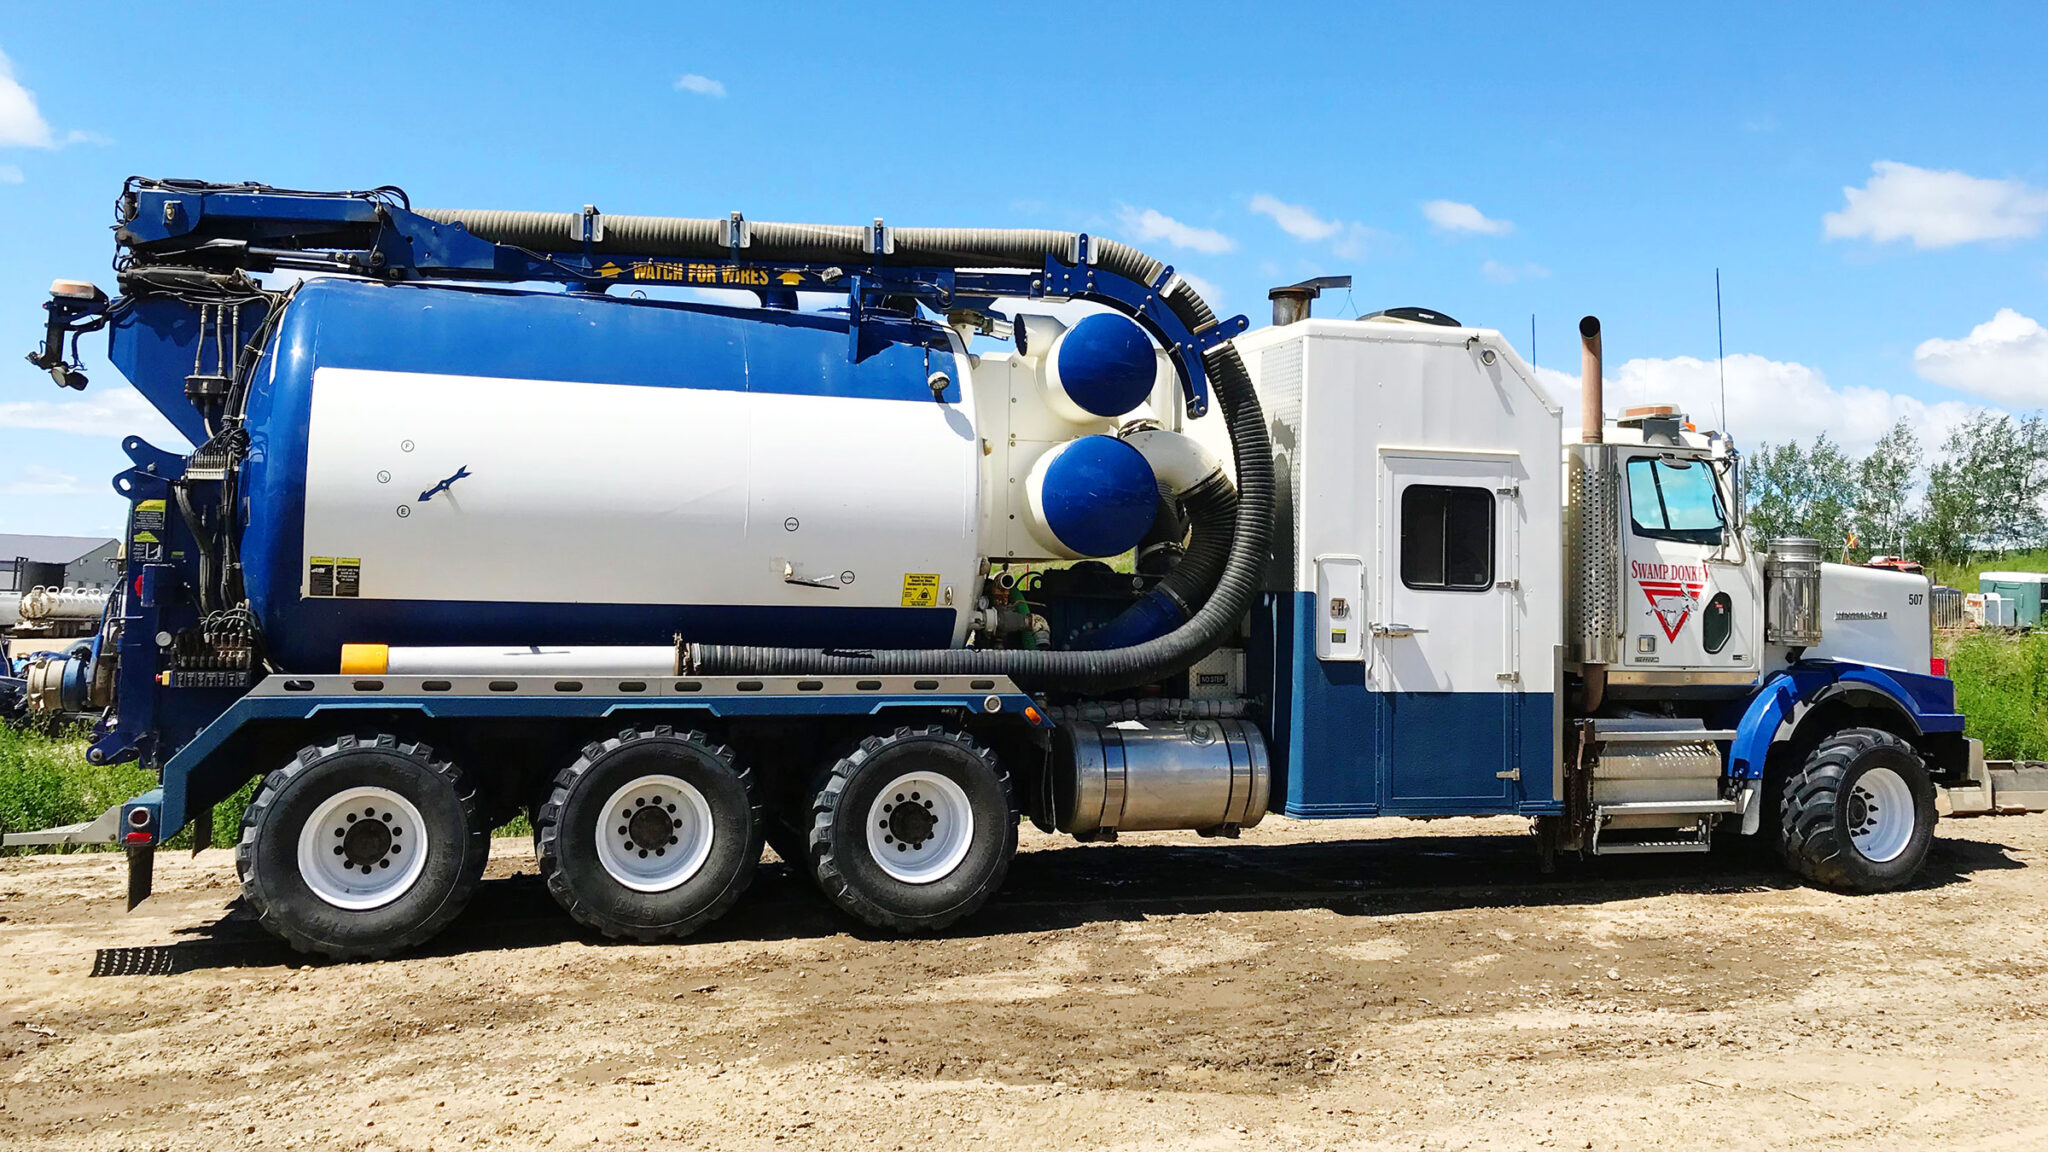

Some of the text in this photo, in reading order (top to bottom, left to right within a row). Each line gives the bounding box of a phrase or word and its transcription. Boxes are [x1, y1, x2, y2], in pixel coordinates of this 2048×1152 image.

[633, 261, 769, 285] WATCH FOR WIRES
[1631, 560, 1711, 582] SWAMP DONKEY
[1908, 594, 1924, 605] 507
